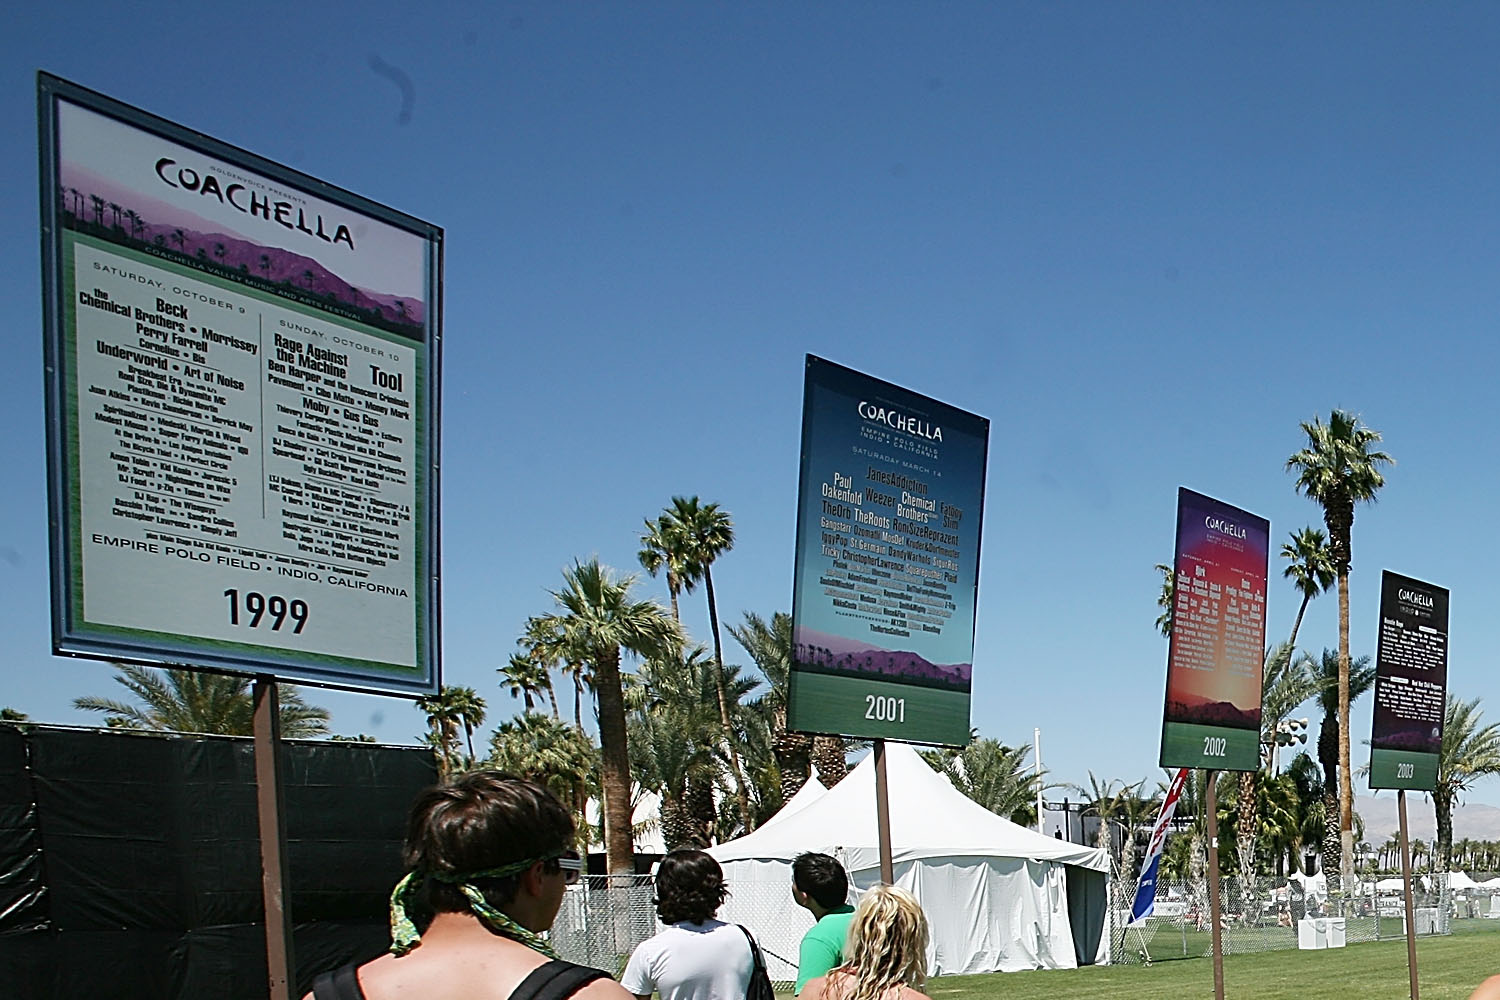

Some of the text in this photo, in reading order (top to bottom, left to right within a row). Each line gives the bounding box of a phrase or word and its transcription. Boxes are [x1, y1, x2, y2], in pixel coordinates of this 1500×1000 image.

[155, 157, 354, 250] COACHELLA
[145, 245, 204, 271] COACHELLA
[206, 265, 242, 283] VALLEY
[245, 278, 275, 293] MUSIC
[277, 288, 296, 300] AND
[299, 296, 322, 309] ARTS
[94, 288, 108, 301] the
[173, 286, 233, 311] OCTOBER
[156, 297, 188, 321] Beck
[79, 291, 258, 356] Chemical Brothers Morrissey
[136, 322, 208, 353] Perry Farrell
[275, 333, 348, 369] Rage Against
[333, 335, 385, 358] OCTOBER
[139, 338, 206, 365] Cornelius Bis
[277, 347, 346, 380] the Machine
[96, 340, 244, 391] Underworld Art of Noise
[268, 359, 285, 374] Ben
[289, 365, 321, 385] Harper
[324, 377, 335, 388] and
[369, 364, 402, 393] Tool
[214, 395, 226, 406] MC
[268, 374, 304, 392] Pavement
[391, 408, 409, 420] Mark
[303, 397, 379, 428] Moby Gus Gus
[858, 401, 943, 442] COACHELLA
[860, 431, 882, 443] INDIO
[893, 442, 938, 460] CALIFORNIA
[861, 425, 890, 440] EMPIRE
[894, 436, 913, 447] POLO
[834, 472, 852, 490] Paul
[902, 461, 929, 475] MARCH
[822, 482, 862, 506] Oakenfold
[865, 488, 896, 509] Weezer
[902, 491, 936, 513] Chemical
[823, 501, 851, 520] TheOrb
[854, 509, 890, 529] TheRoots
[897, 503, 929, 524] Brothers
[1205, 516, 1246, 540] COACHELLA
[92, 534, 408, 598] EMPIRE POLO FIELD INDIO, CALIFORNIA
[224, 587, 309, 635] 1999
[1398, 588, 1434, 608] COACHELLA
[865, 694, 905, 722] 2001
[1204, 736, 1226, 756] 2002
[1397, 763, 1414, 778] 2003
